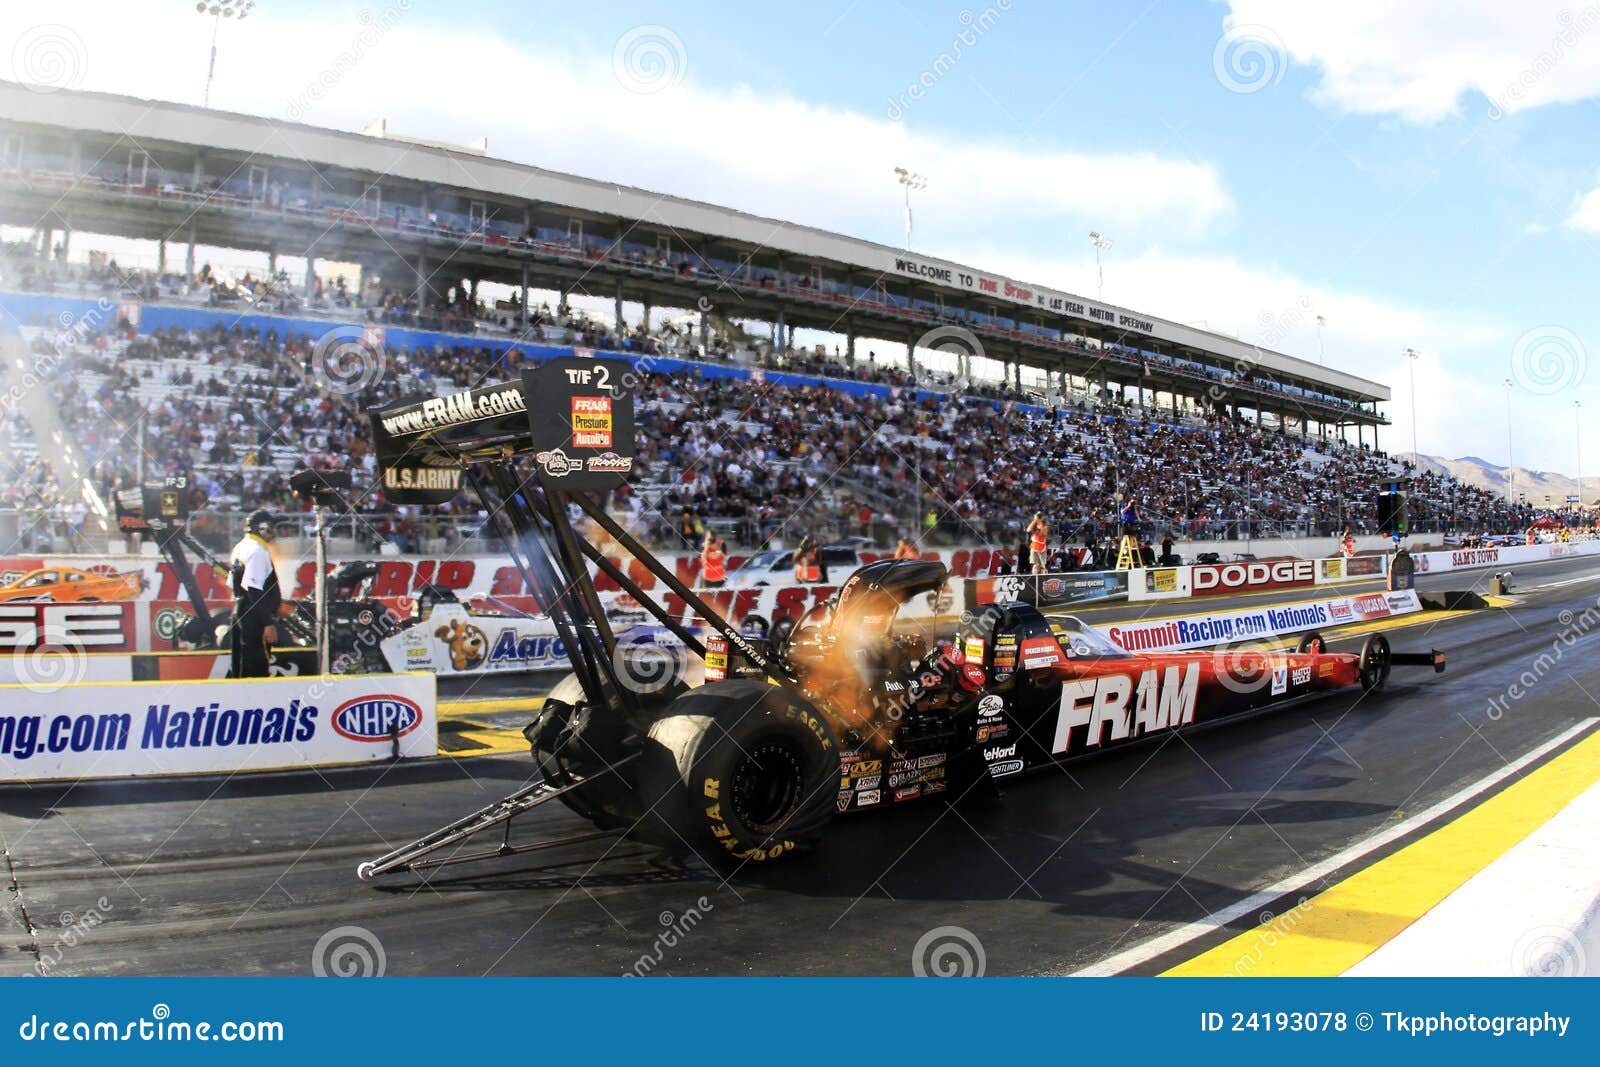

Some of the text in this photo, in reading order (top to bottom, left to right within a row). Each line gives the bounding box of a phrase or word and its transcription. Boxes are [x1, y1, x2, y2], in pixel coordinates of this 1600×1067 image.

[896, 259, 952, 282] WELCOME
[959, 274, 973, 287] TO
[978, 277, 998, 293] THE
[1050, 298, 1063, 310] LAS
[1065, 302, 1085, 315] VEGAS
[1089, 308, 1115, 322] MOTOR
[1119, 315, 1154, 333] SPEEDWAY
[593, 365, 613, 389] 2
[382, 387, 527, 436] www.FRAM.com
[575, 400, 609, 412] FRAM
[1452, 549, 1499, 567] SAM'S TOWN
[1193, 561, 1313, 589] DODGE
[1109, 603, 1327, 651] SummitRacing.com Nationals
[724, 627, 767, 668] GOODYEAR
[1292, 666, 1312, 678] MATCO
[1292, 675, 1311, 687] TOOLS
[345, 701, 411, 735] NHRA
[1052, 661, 1201, 755] FRAM
[141, 699, 319, 750] Nationals
[984, 743, 1017, 761] ieHard
